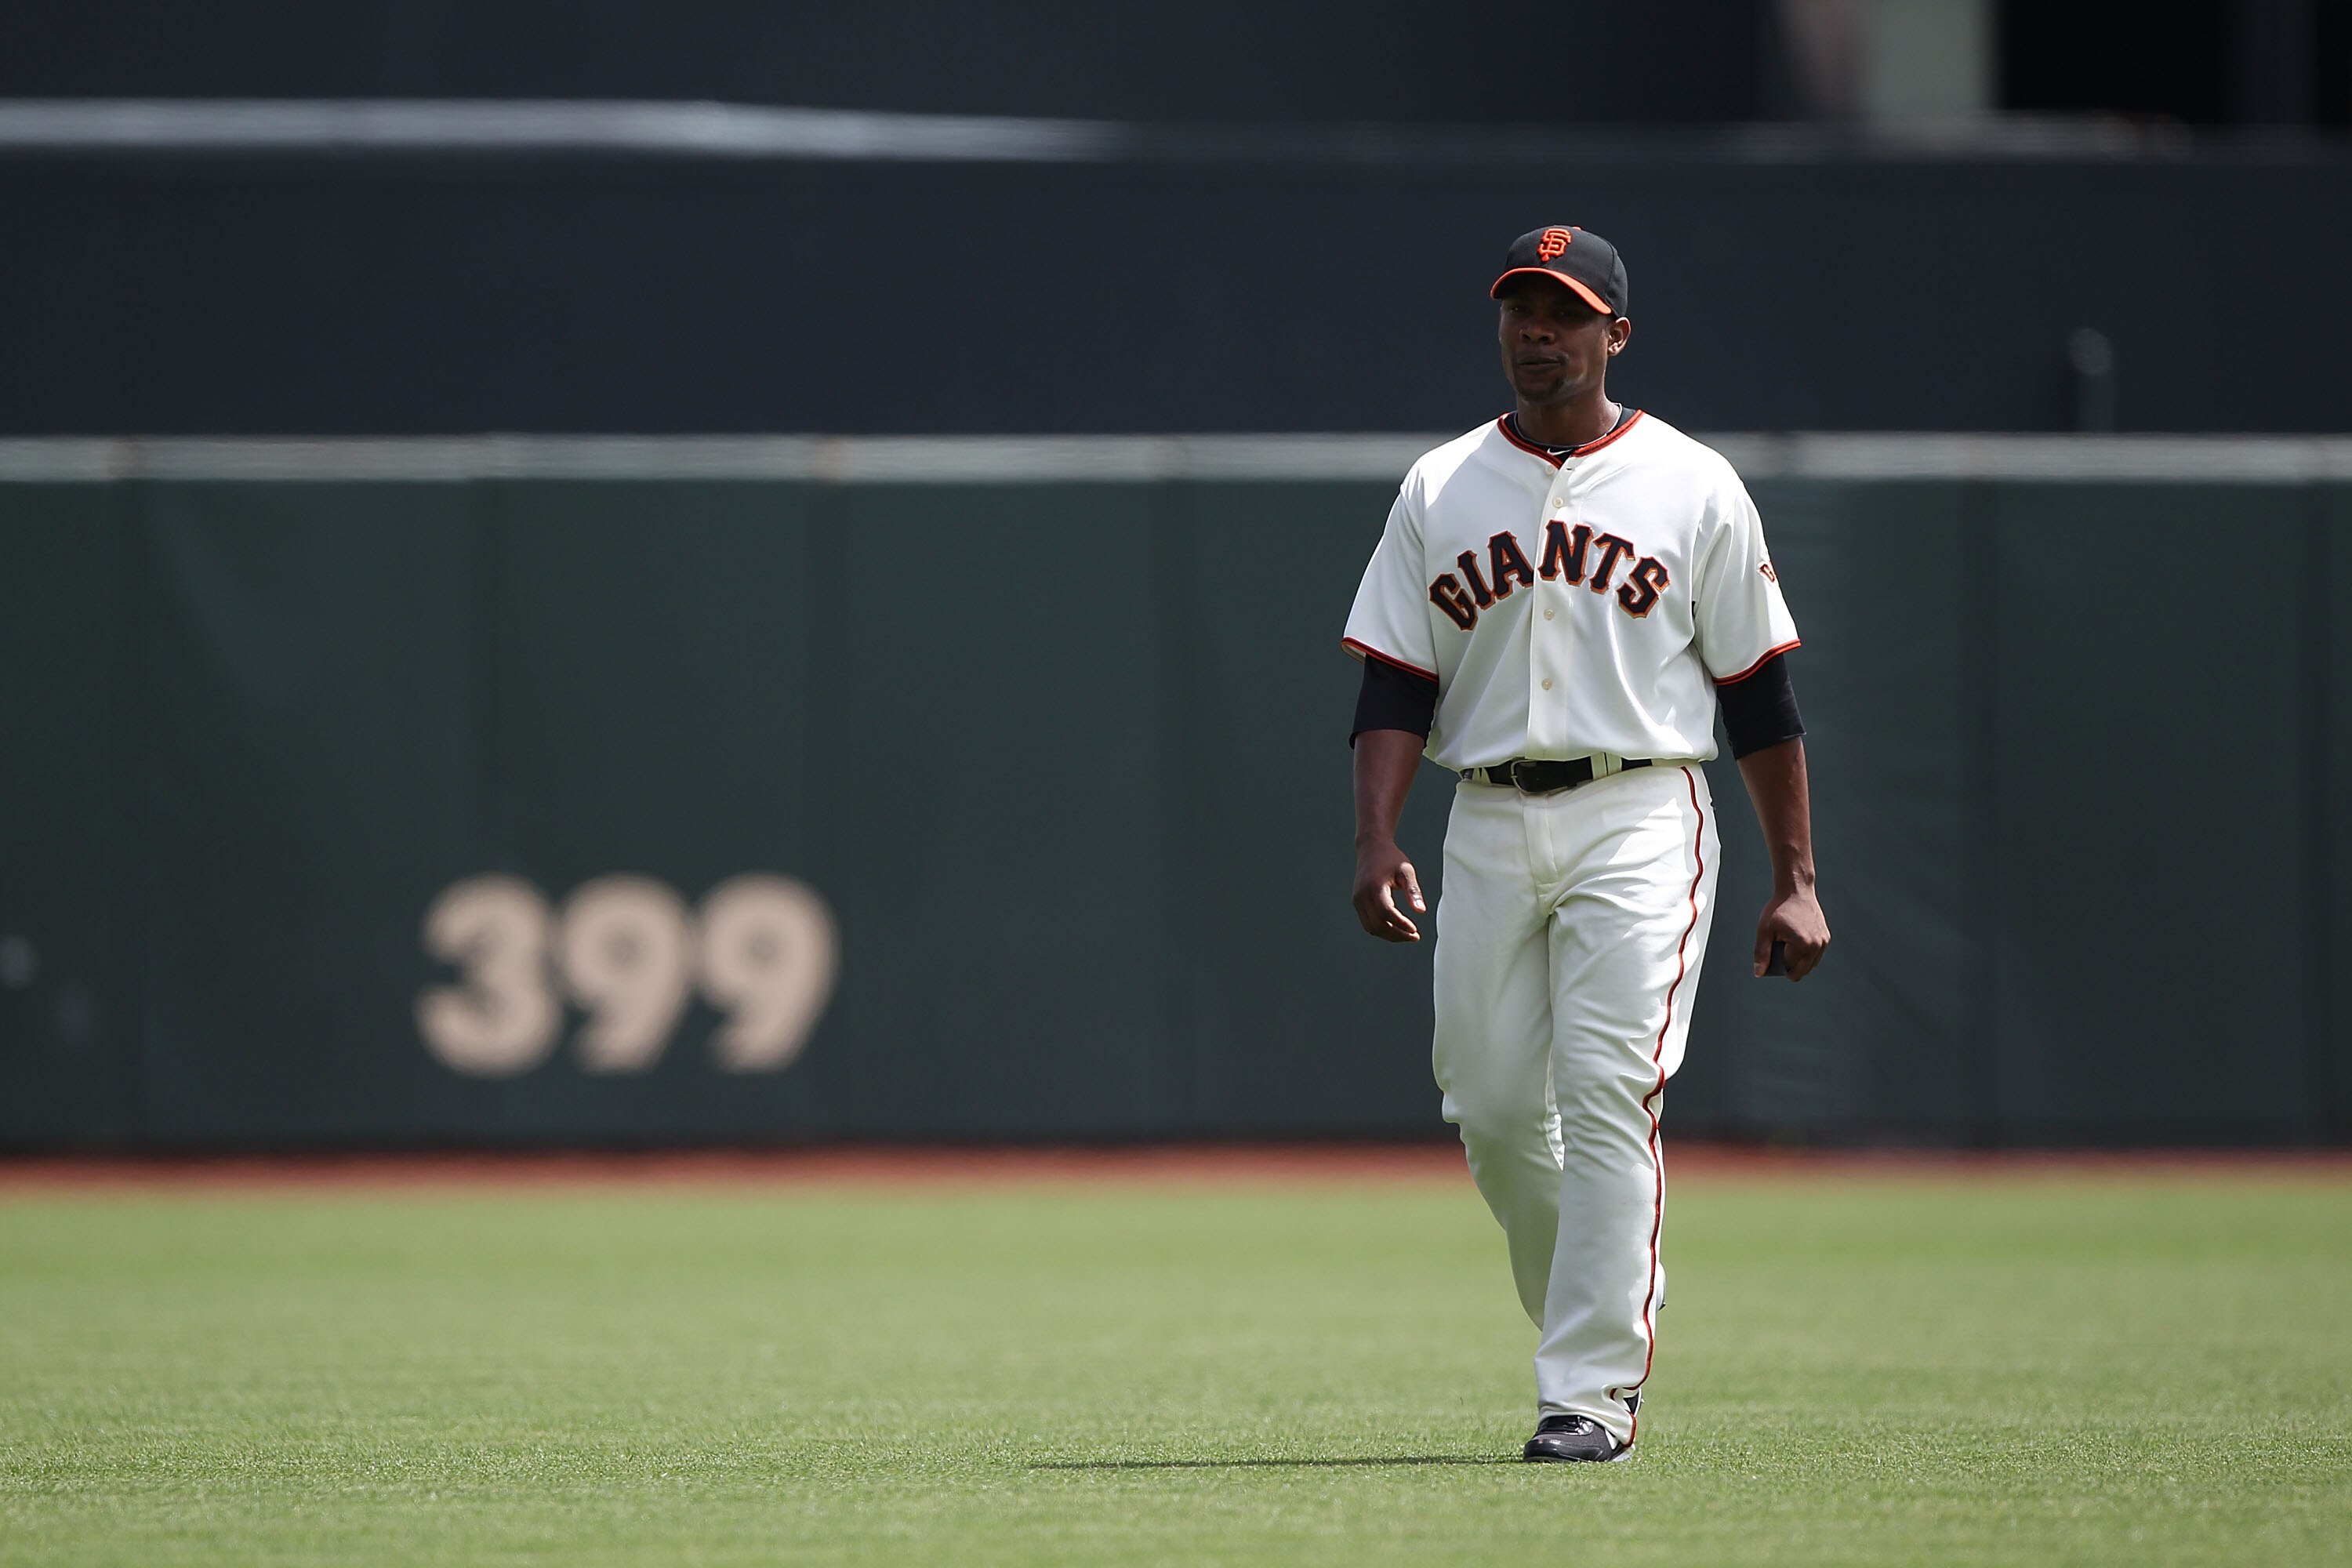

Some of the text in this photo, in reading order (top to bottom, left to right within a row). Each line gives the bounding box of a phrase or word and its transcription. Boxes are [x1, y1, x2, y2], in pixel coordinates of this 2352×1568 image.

[1537, 227, 1571, 262] SF
[1429, 519, 1670, 630] GIANTS
[416, 873, 837, 1075] 399
